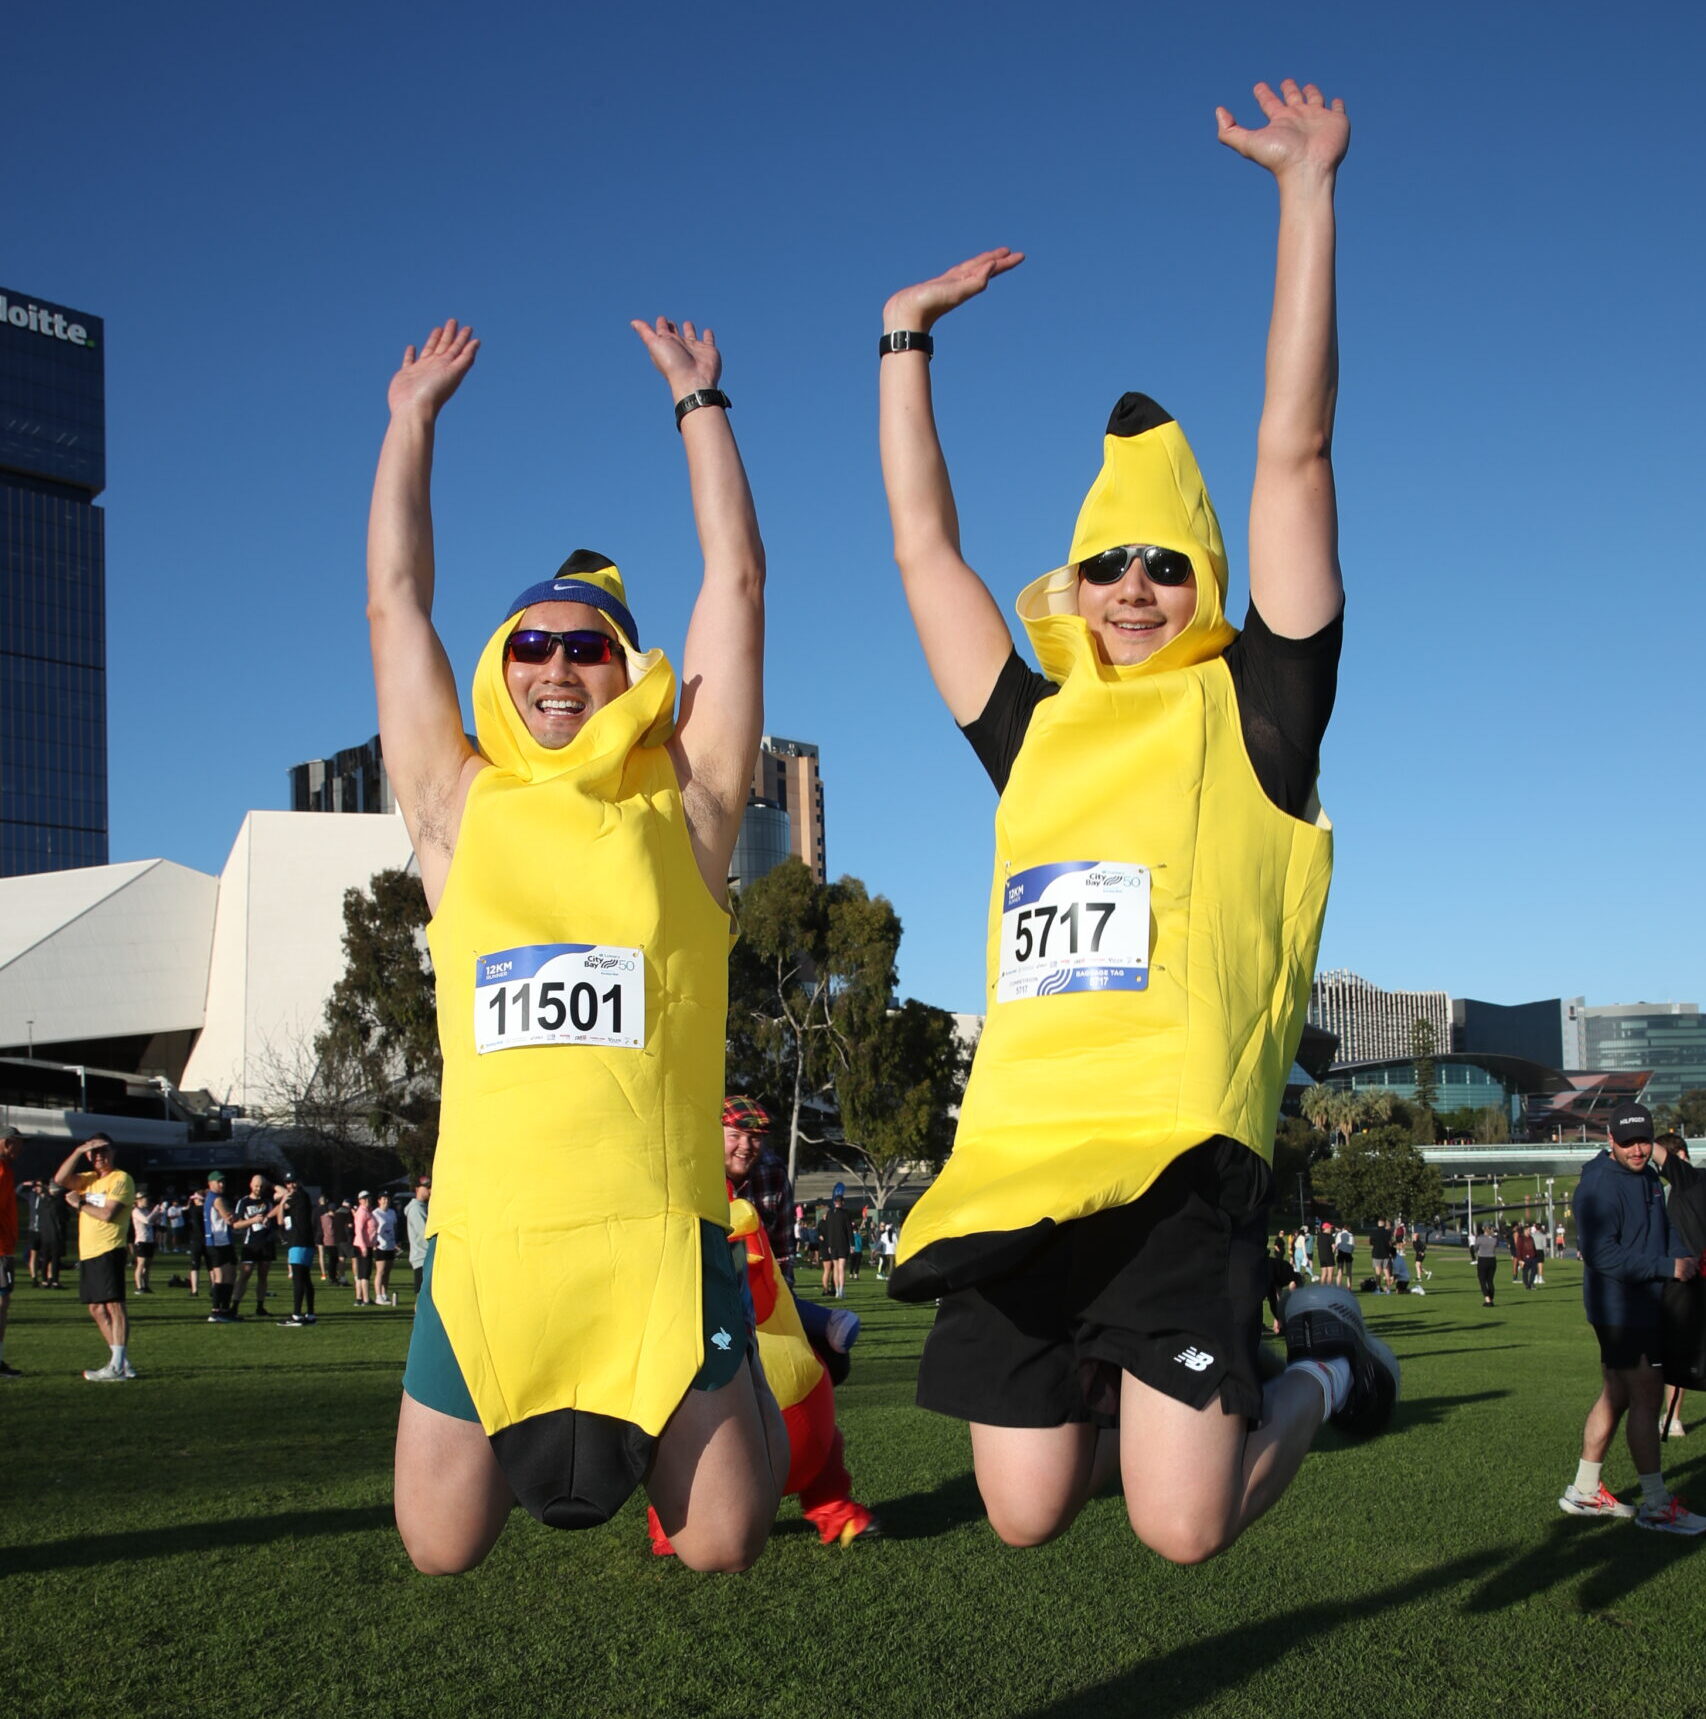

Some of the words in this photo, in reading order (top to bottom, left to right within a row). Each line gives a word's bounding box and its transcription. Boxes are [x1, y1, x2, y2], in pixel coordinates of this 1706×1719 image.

[1015, 902, 1116, 963] 5717
[584, 960, 599, 970] Bay
[587, 955, 604, 964] City
[619, 959, 635, 972] 50
[485, 960, 512, 976] 12KM
[489, 982, 622, 1035] 11501
